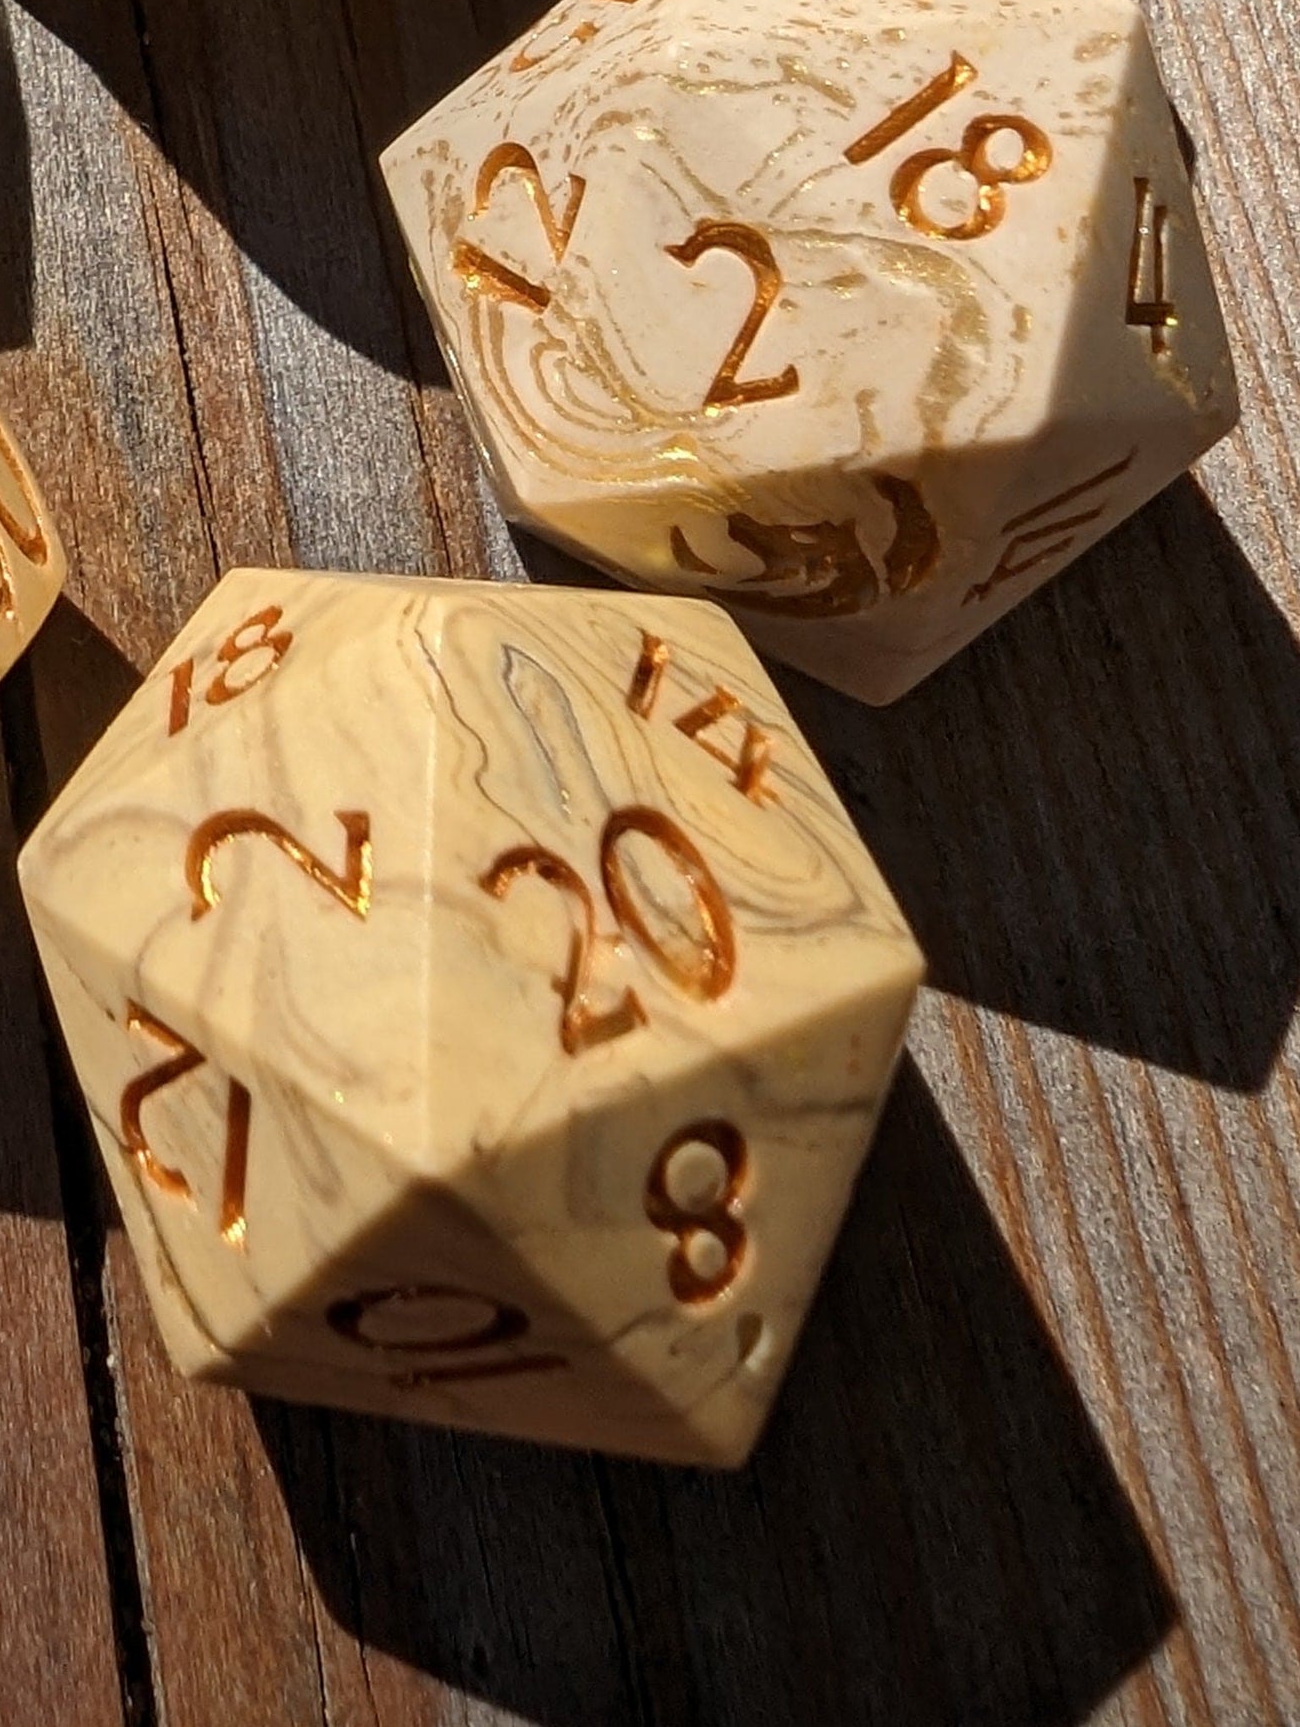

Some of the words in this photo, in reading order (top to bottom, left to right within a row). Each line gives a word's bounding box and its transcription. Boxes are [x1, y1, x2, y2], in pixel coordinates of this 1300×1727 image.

[843, 50, 1053, 241] 18
[665, 217, 801, 414] 2
[1125, 177, 1178, 354] 4
[167, 605, 293, 737] 18
[625, 628, 783, 808] 14
[184, 808, 373, 923] 2
[480, 805, 737, 1056] 20
[645, 1120, 750, 1305] 8
